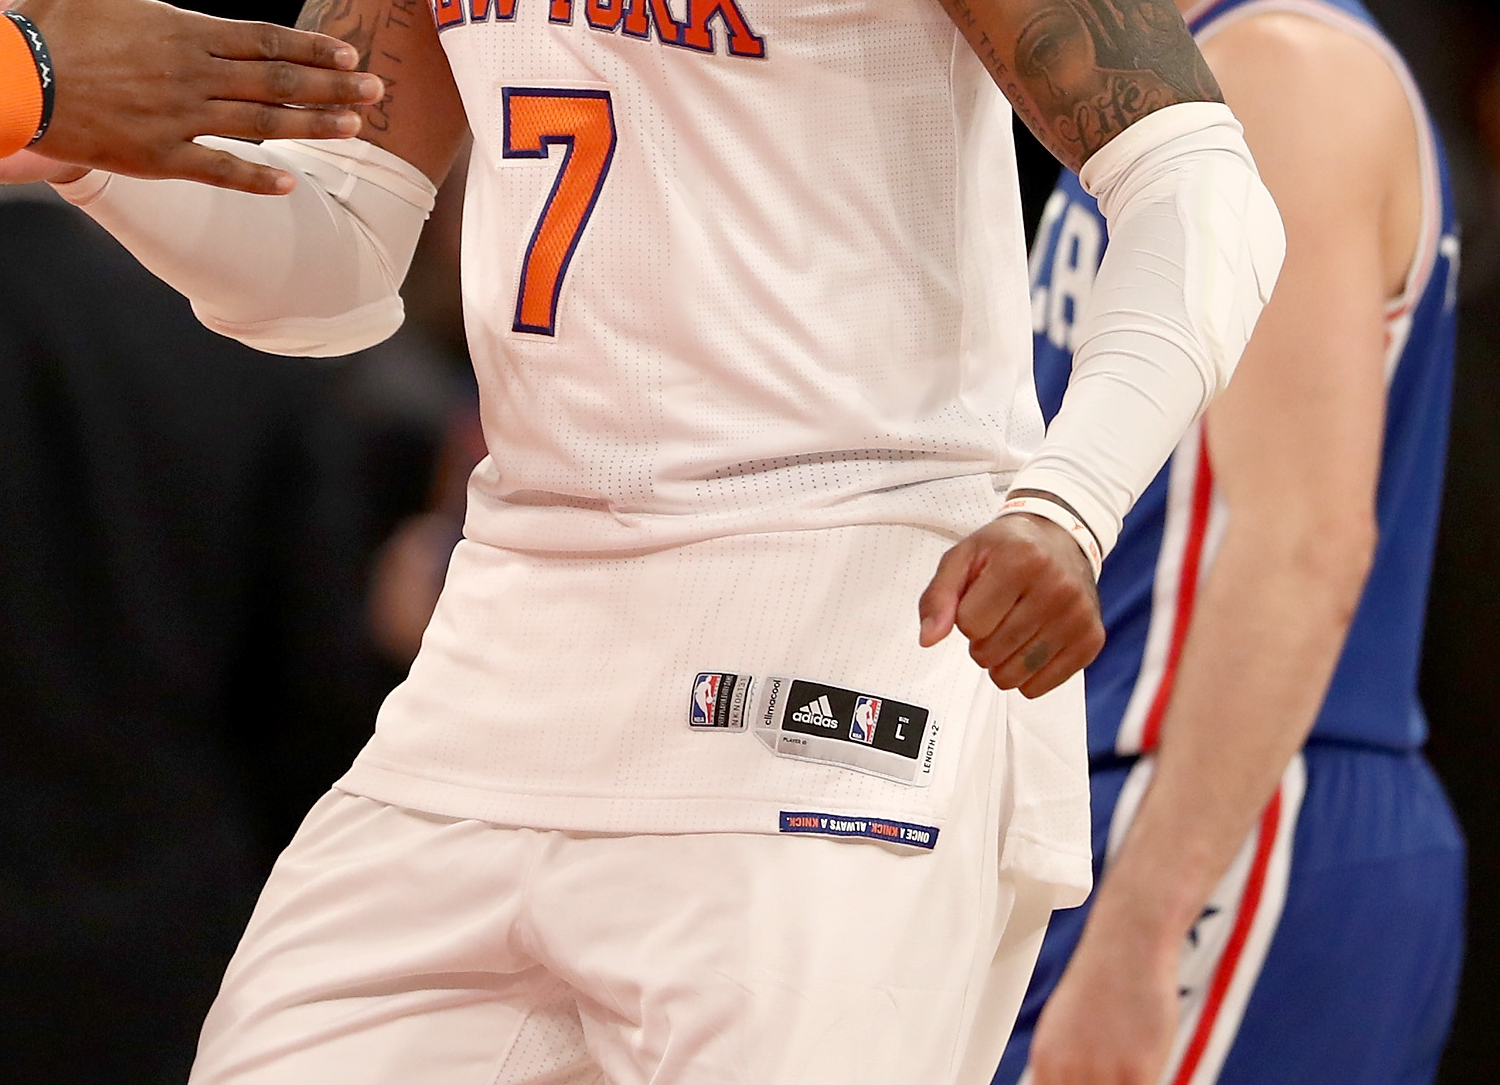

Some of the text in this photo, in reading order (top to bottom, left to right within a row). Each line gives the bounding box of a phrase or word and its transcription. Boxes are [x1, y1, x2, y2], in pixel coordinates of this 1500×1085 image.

[502, 87, 617, 337] 7
[764, 679, 781, 726] climacool
[792, 711, 839, 729] adidas
[895, 724, 906, 741] L
[923, 739, 936, 773] LENGTH
[786, 817, 819, 828] KNICK.
[820, 818, 828, 829] A
[830, 819, 867, 832] ALWAYS
[906, 828, 930, 844] ONCE
